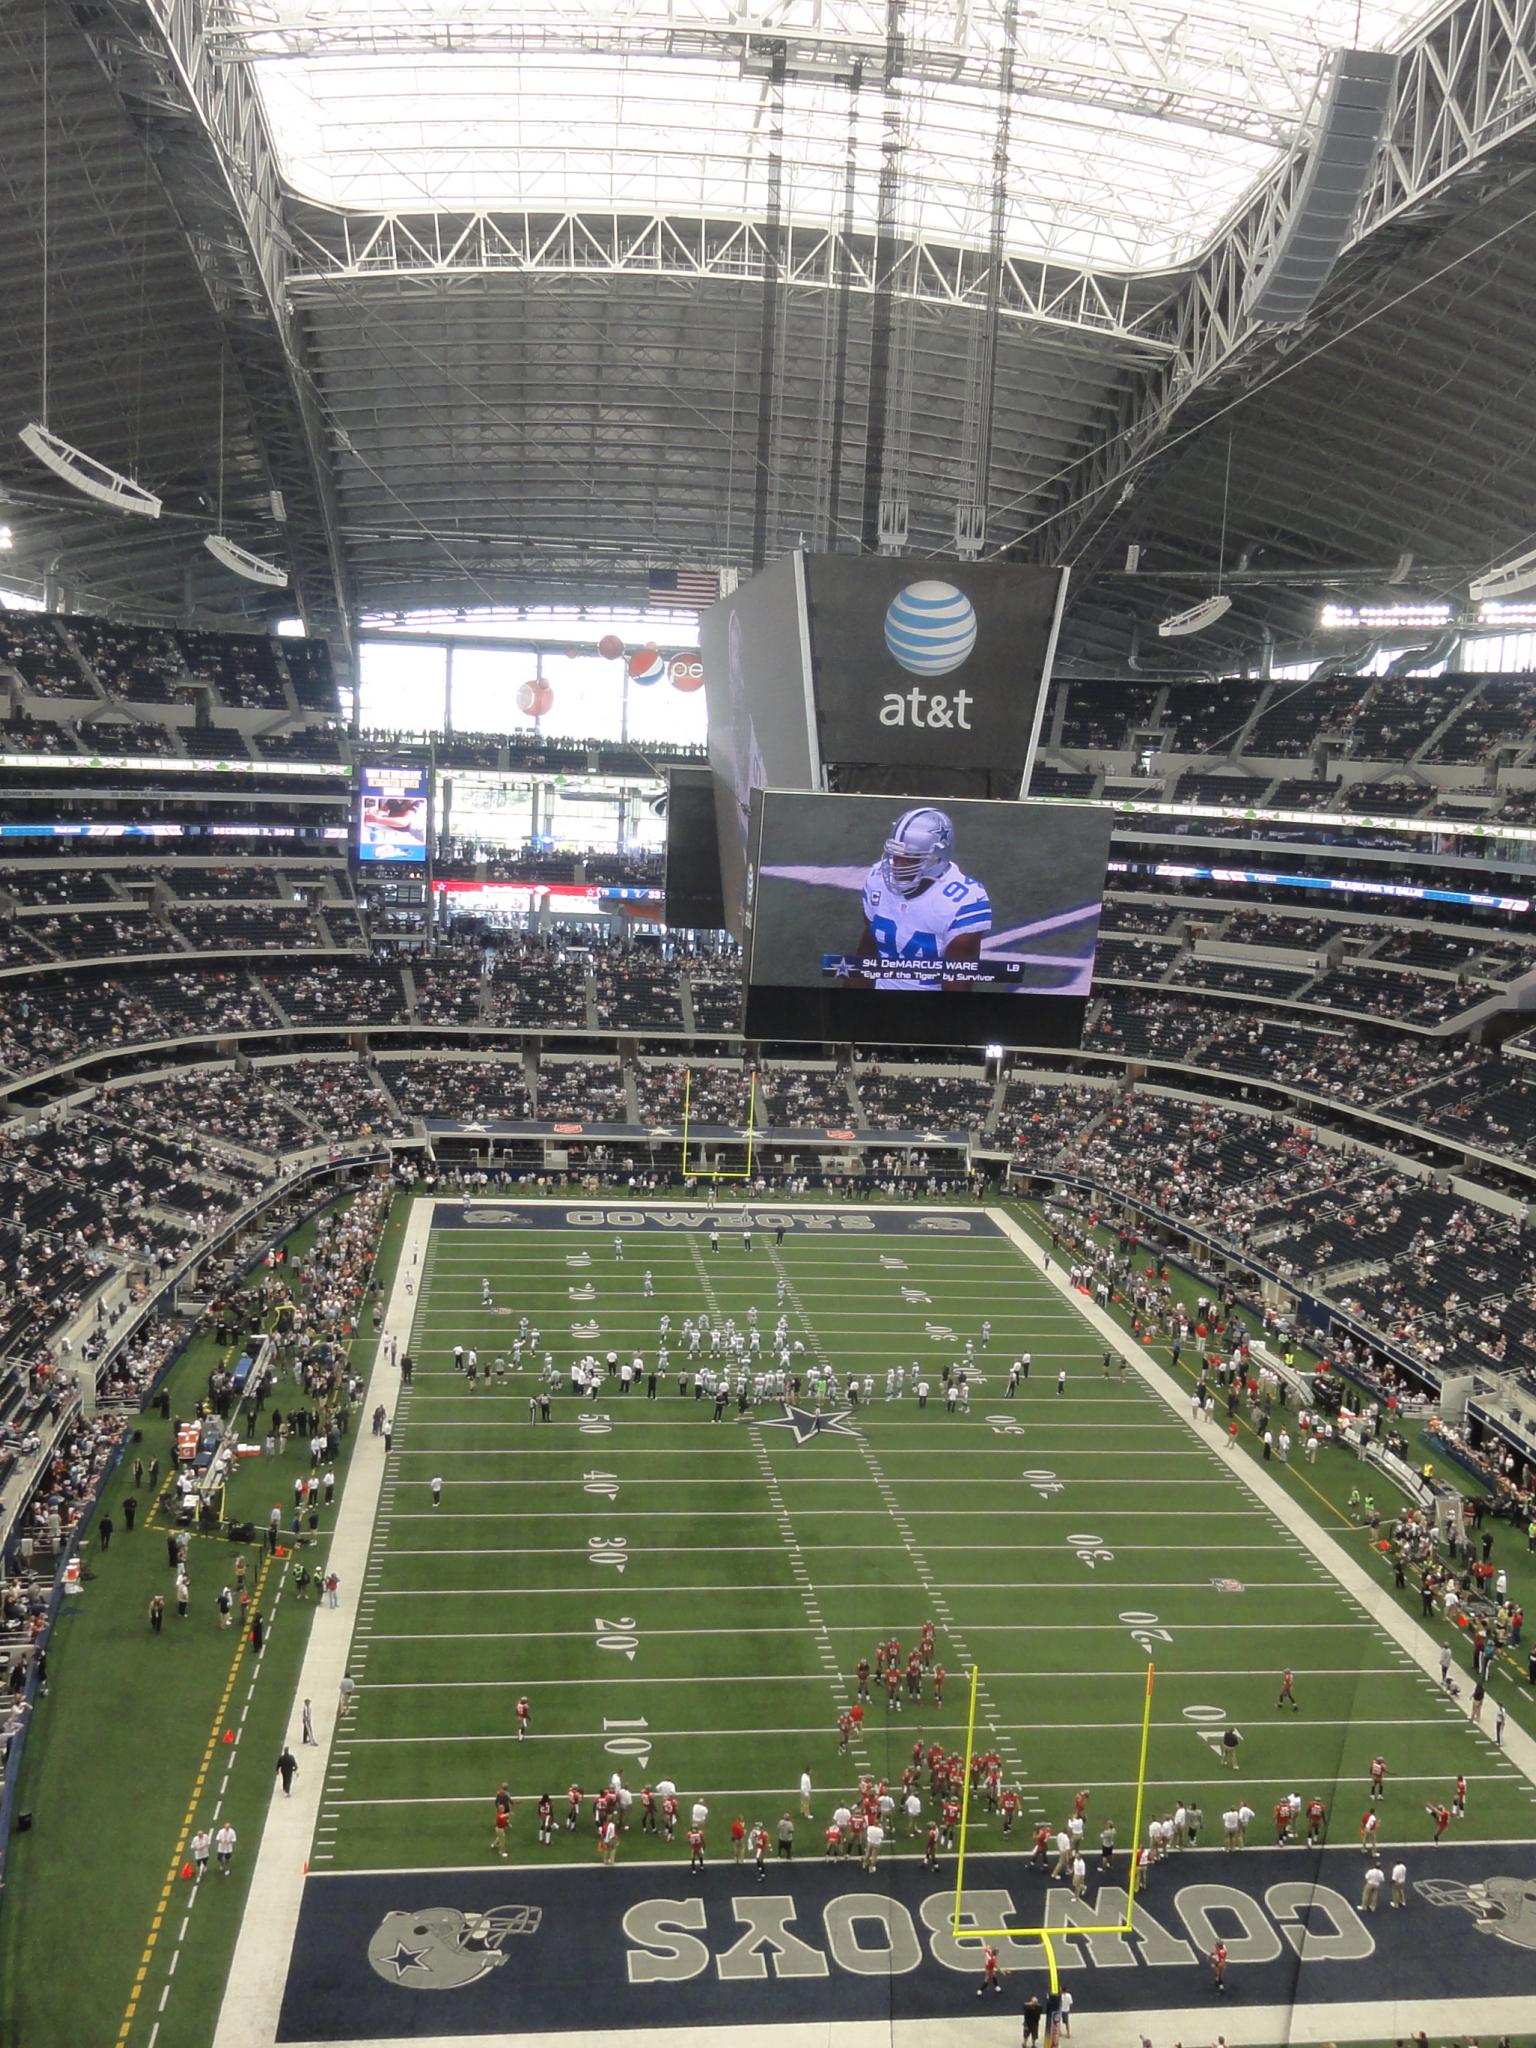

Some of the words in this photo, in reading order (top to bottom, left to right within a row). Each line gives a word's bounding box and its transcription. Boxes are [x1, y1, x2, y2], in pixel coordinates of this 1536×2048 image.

[879, 687, 974, 730] at&t
[212, 826, 260, 836] DECEMBER
[862, 958, 877, 967] 94
[881, 959, 943, 969] DeMARCUS
[946, 961, 978, 971] WARE
[1007, 963, 1020, 973] LB
[883, 970, 894, 979] of
[896, 971, 911, 979] the
[942, 972, 954, 982] by
[956, 973, 995, 983] Survivor
[565, 1211, 876, 1230] COWBOYS
[578, 1412, 612, 1434] 50
[985, 1415, 1025, 1435] 50
[583, 1470, 620, 1493] 40
[1022, 1470, 1065, 1492] 40
[588, 1536, 628, 1564] 30
[1066, 1534, 1114, 1561] 30
[594, 1616, 639, 1650] 20
[1118, 1611, 1174, 1643] 20
[1182, 1705, 1244, 1741] 10
[603, 1716, 652, 1755] 10
[621, 1880, 1376, 1984] COWBOYS
